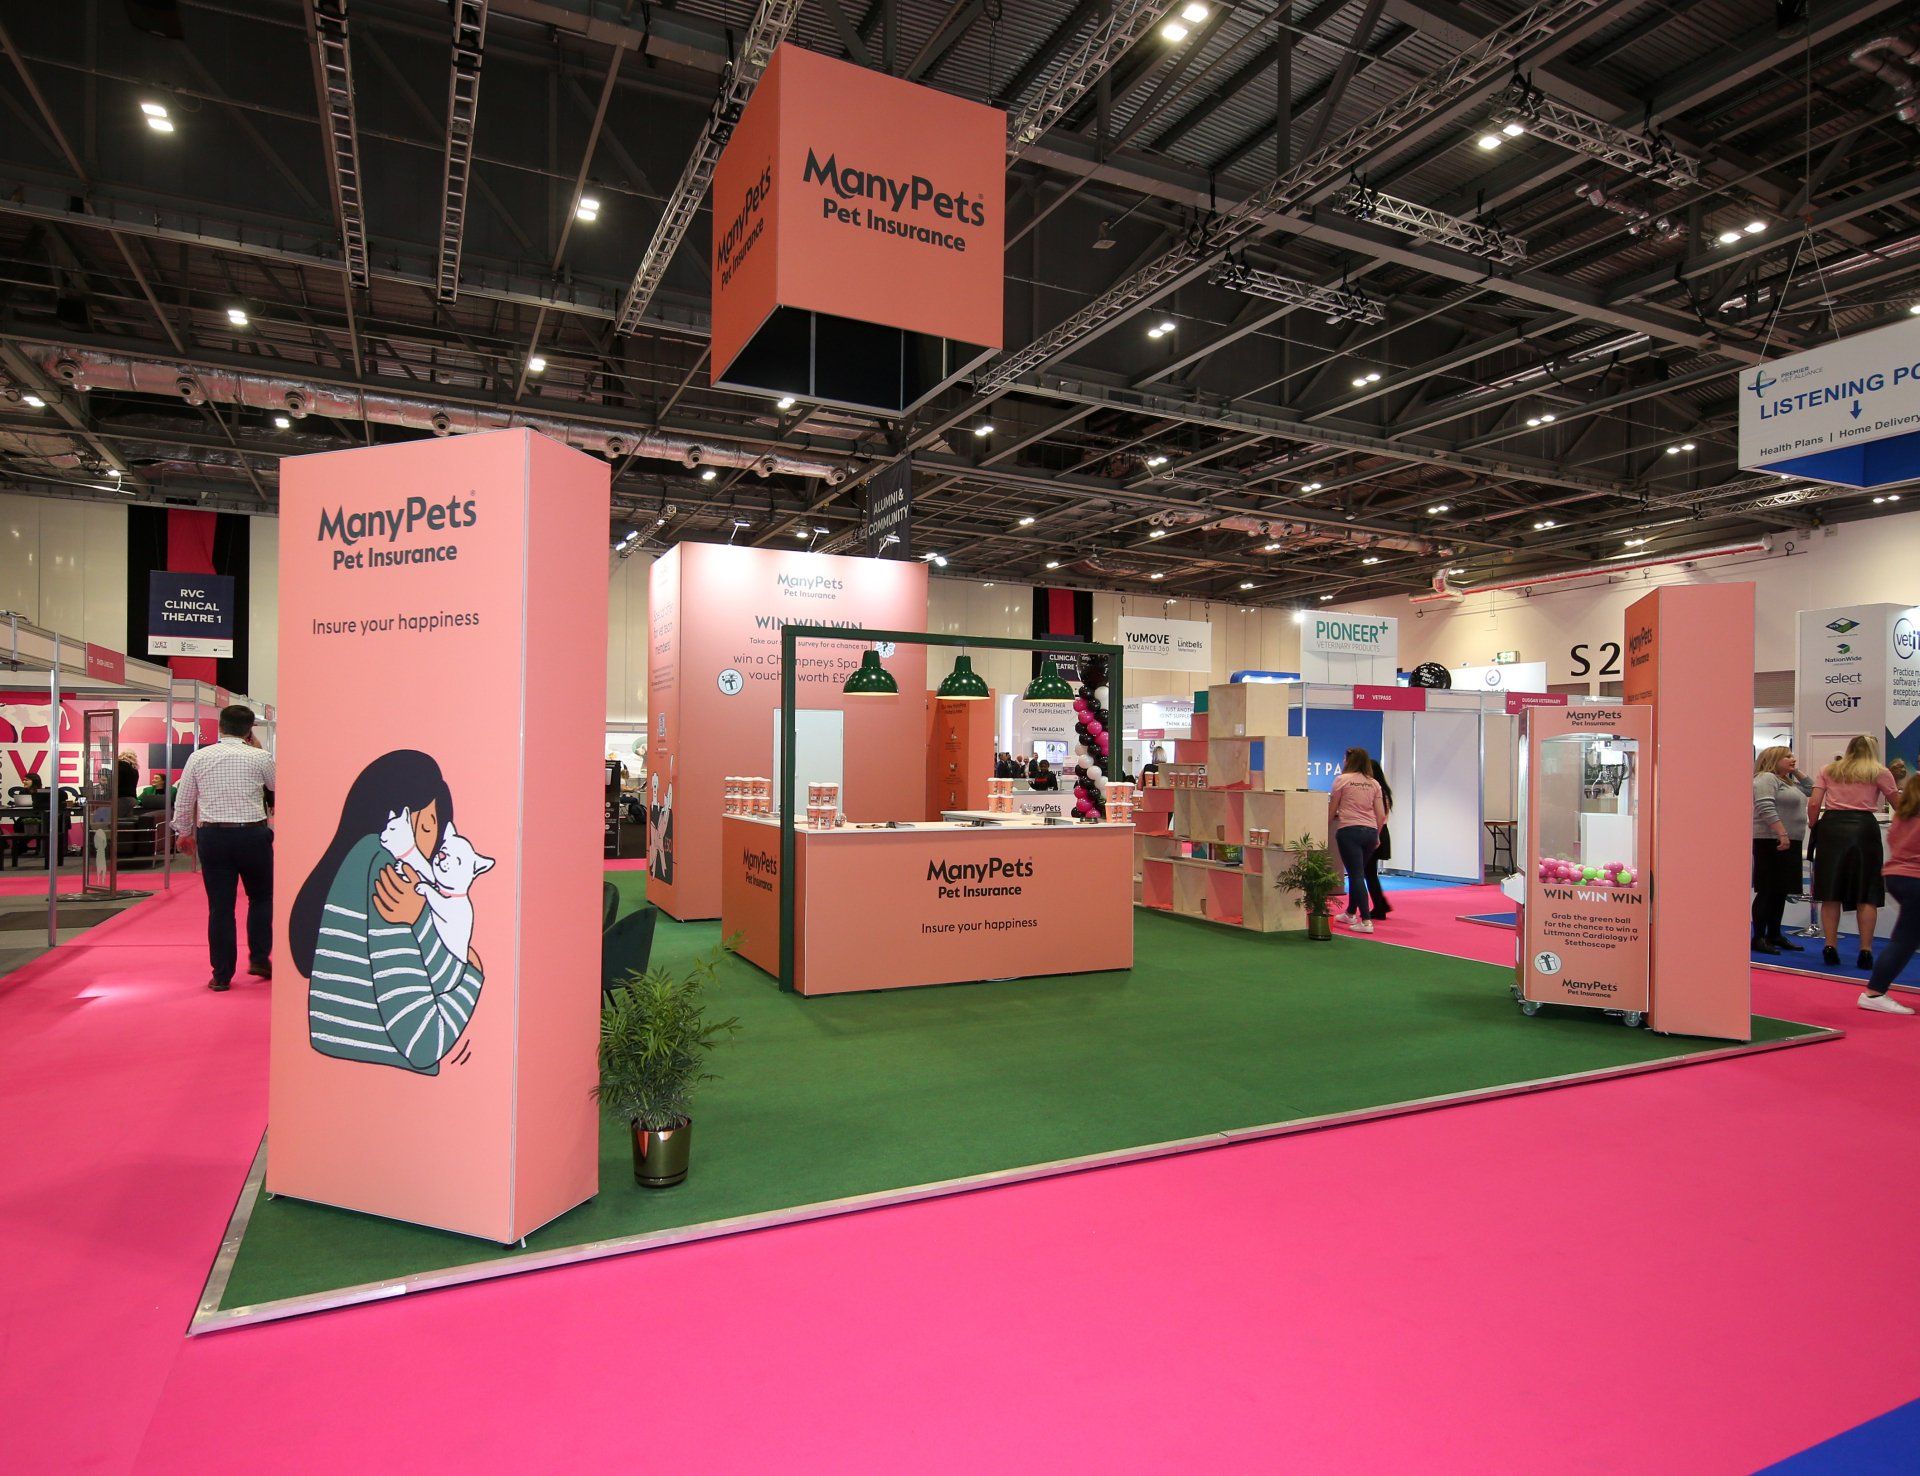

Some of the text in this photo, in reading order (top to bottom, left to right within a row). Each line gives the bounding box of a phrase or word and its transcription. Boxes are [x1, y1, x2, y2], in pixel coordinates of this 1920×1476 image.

[803, 146, 985, 227] ManyPets
[717, 165, 771, 272] ManyPets
[823, 197, 966, 252] Pet Insurance
[721, 217, 764, 290] Pet Insurance
[1780, 366, 1809, 378] PREMIER
[1794, 367, 1824, 381] ALLIANCE
[1760, 373, 1885, 420] LISTENING
[1760, 443, 1792, 457] Health
[1795, 435, 1824, 449] Plans
[1839, 425, 1871, 438] Home
[874, 488, 904, 515] ALUMNI &
[317, 494, 477, 546] ManyPets
[868, 505, 909, 536] COMMUNITY
[333, 545, 458, 570] Pet Insurance
[777, 573, 843, 589] ManyPets
[180, 588, 205, 598] RVC
[784, 589, 836, 600] Pet Insurance
[164, 600, 220, 611] CLINICAL
[161, 612, 222, 623] THEATRE 1
[312, 610, 480, 636] Insure your happiness
[755, 615, 789, 630] WIN
[750, 637, 766, 645] Take
[798, 641, 819, 649] survey
[837, 642, 859, 650] chance
[1177, 640, 1203, 649] Lintbells
[1317, 641, 1380, 652] VETERINARY PRODUCTS
[1128, 644, 1157, 652] ADVANCE
[733, 653, 753, 664] win
[756, 656, 764, 664] a
[837, 658, 858, 669] Spa
[1049, 654, 1077, 662] CLINICAL
[798, 672, 829, 683] worth
[1825, 672, 1862, 684] select
[1893, 667, 1914, 677] Practice
[1893, 677, 1917, 687] software
[1566, 710, 1622, 721] ManyPets
[743, 847, 777, 875] ManyPets
[927, 858, 1033, 884] ManyPets
[938, 885, 1022, 898] Pet Insurance
[1544, 888, 1642, 904] WIN WIN WIN
[1551, 912, 1571, 920] Grab
[922, 918, 1038, 934] Insure your happiness
[1558, 921, 1571, 929] the
[1573, 923, 1603, 931] chance
[1543, 929, 1580, 938] Littmann
[1582, 932, 1628, 942] Cardiology
[1565, 939, 1616, 949] Stethoscope
[1562, 979, 1618, 992] ManyPets
[1580, 990, 1611, 998] Insurance
